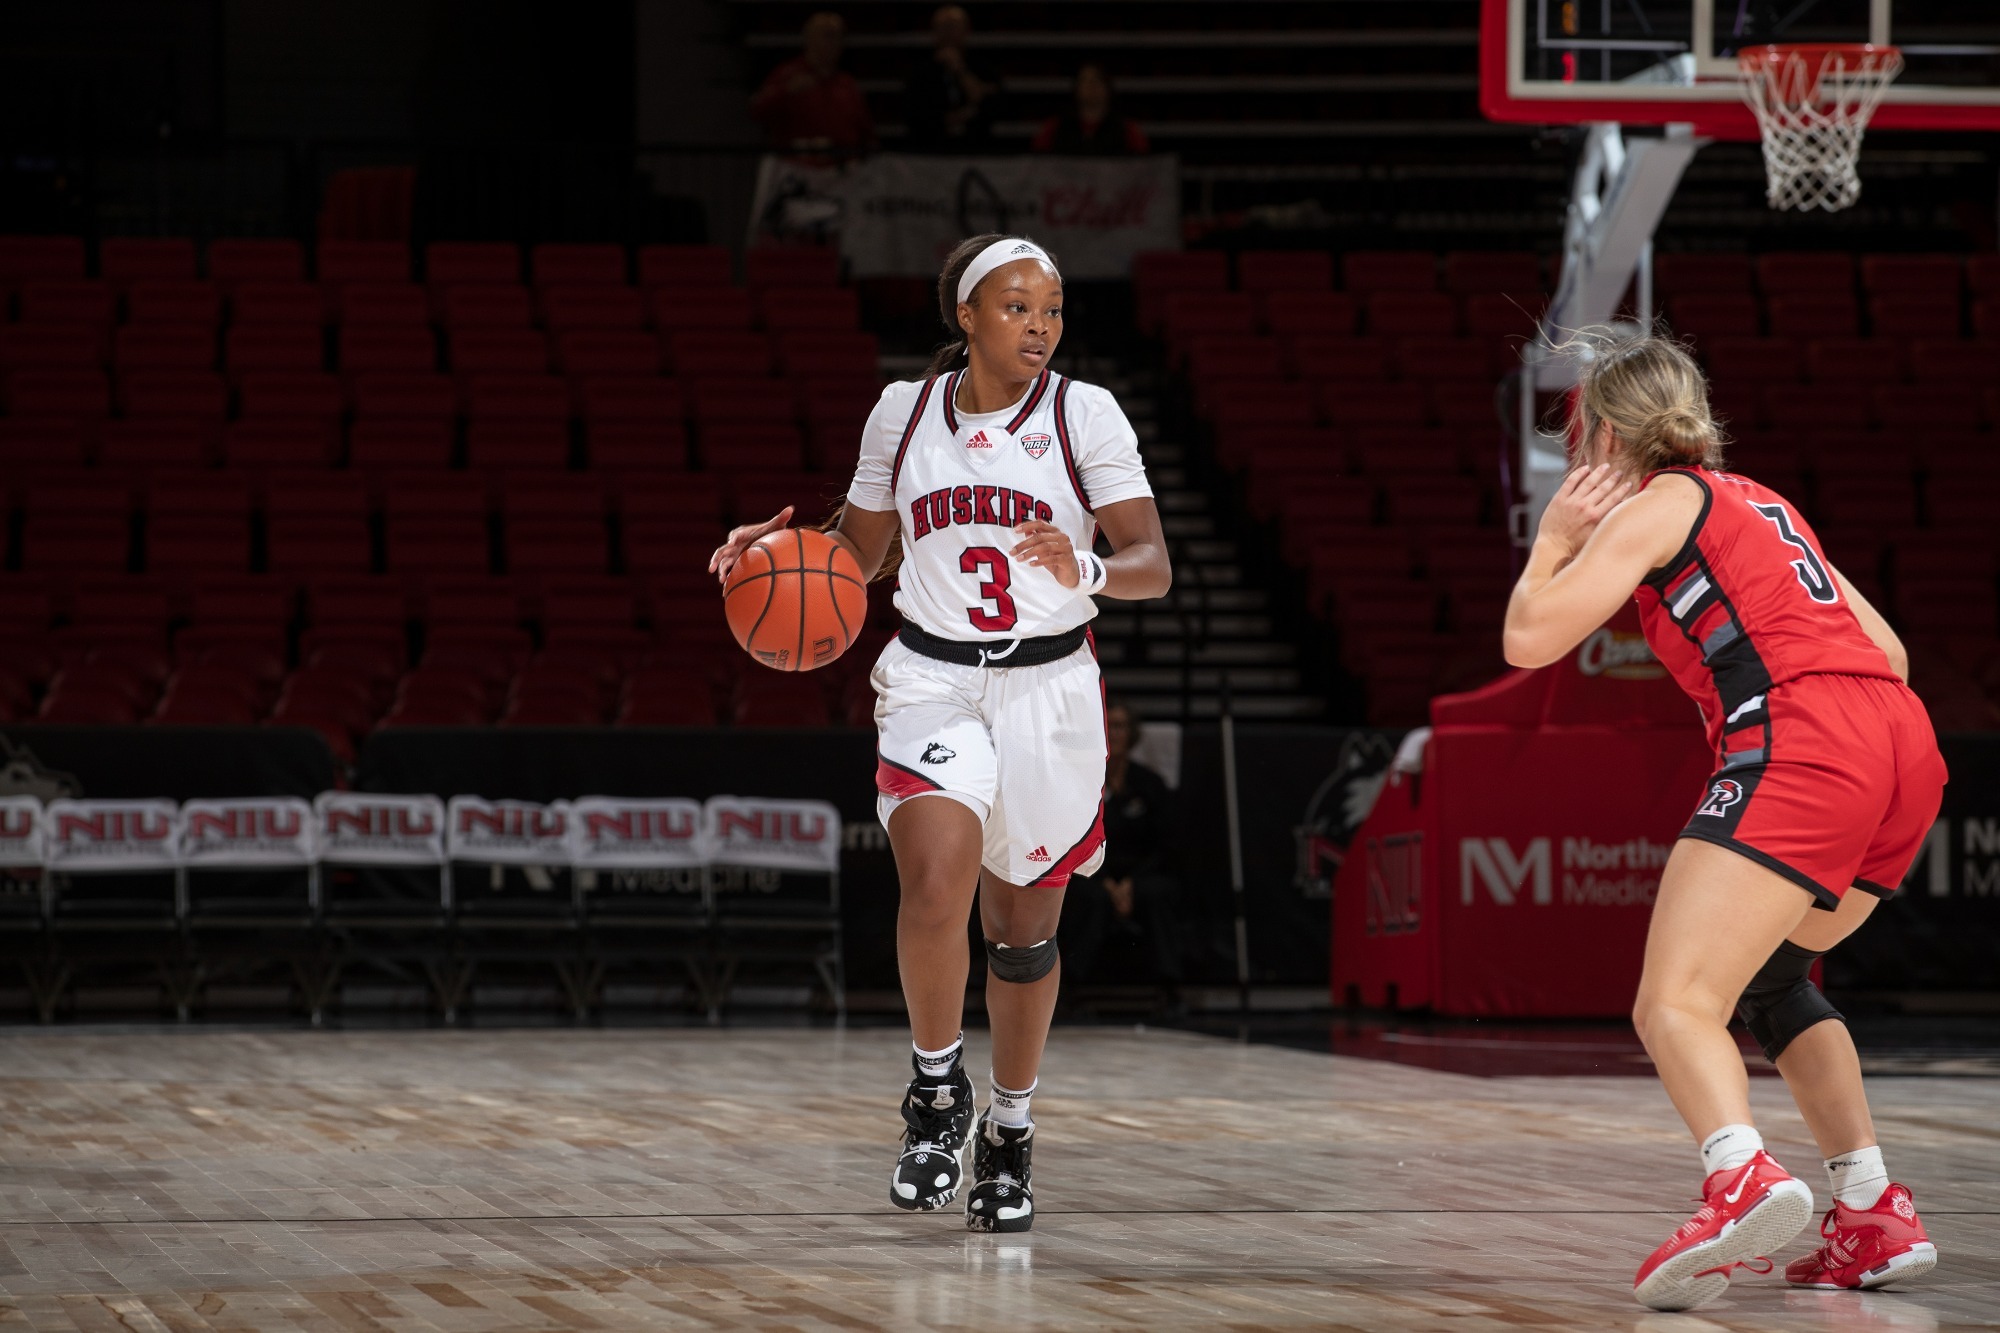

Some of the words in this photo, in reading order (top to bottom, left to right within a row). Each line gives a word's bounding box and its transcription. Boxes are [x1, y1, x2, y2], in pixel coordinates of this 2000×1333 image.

[966, 441, 993, 449] adidas
[1745, 499, 1838, 604] 3
[959, 546, 1018, 632] 3
[58, 811, 170, 841] NIU
[191, 809, 300, 839] NIU
[327, 807, 434, 836] NIU
[460, 808, 565, 837] NIU
[586, 810, 693, 840] NIU
[719, 810, 826, 842] NIU
[1025, 854, 1052, 862] adidas
